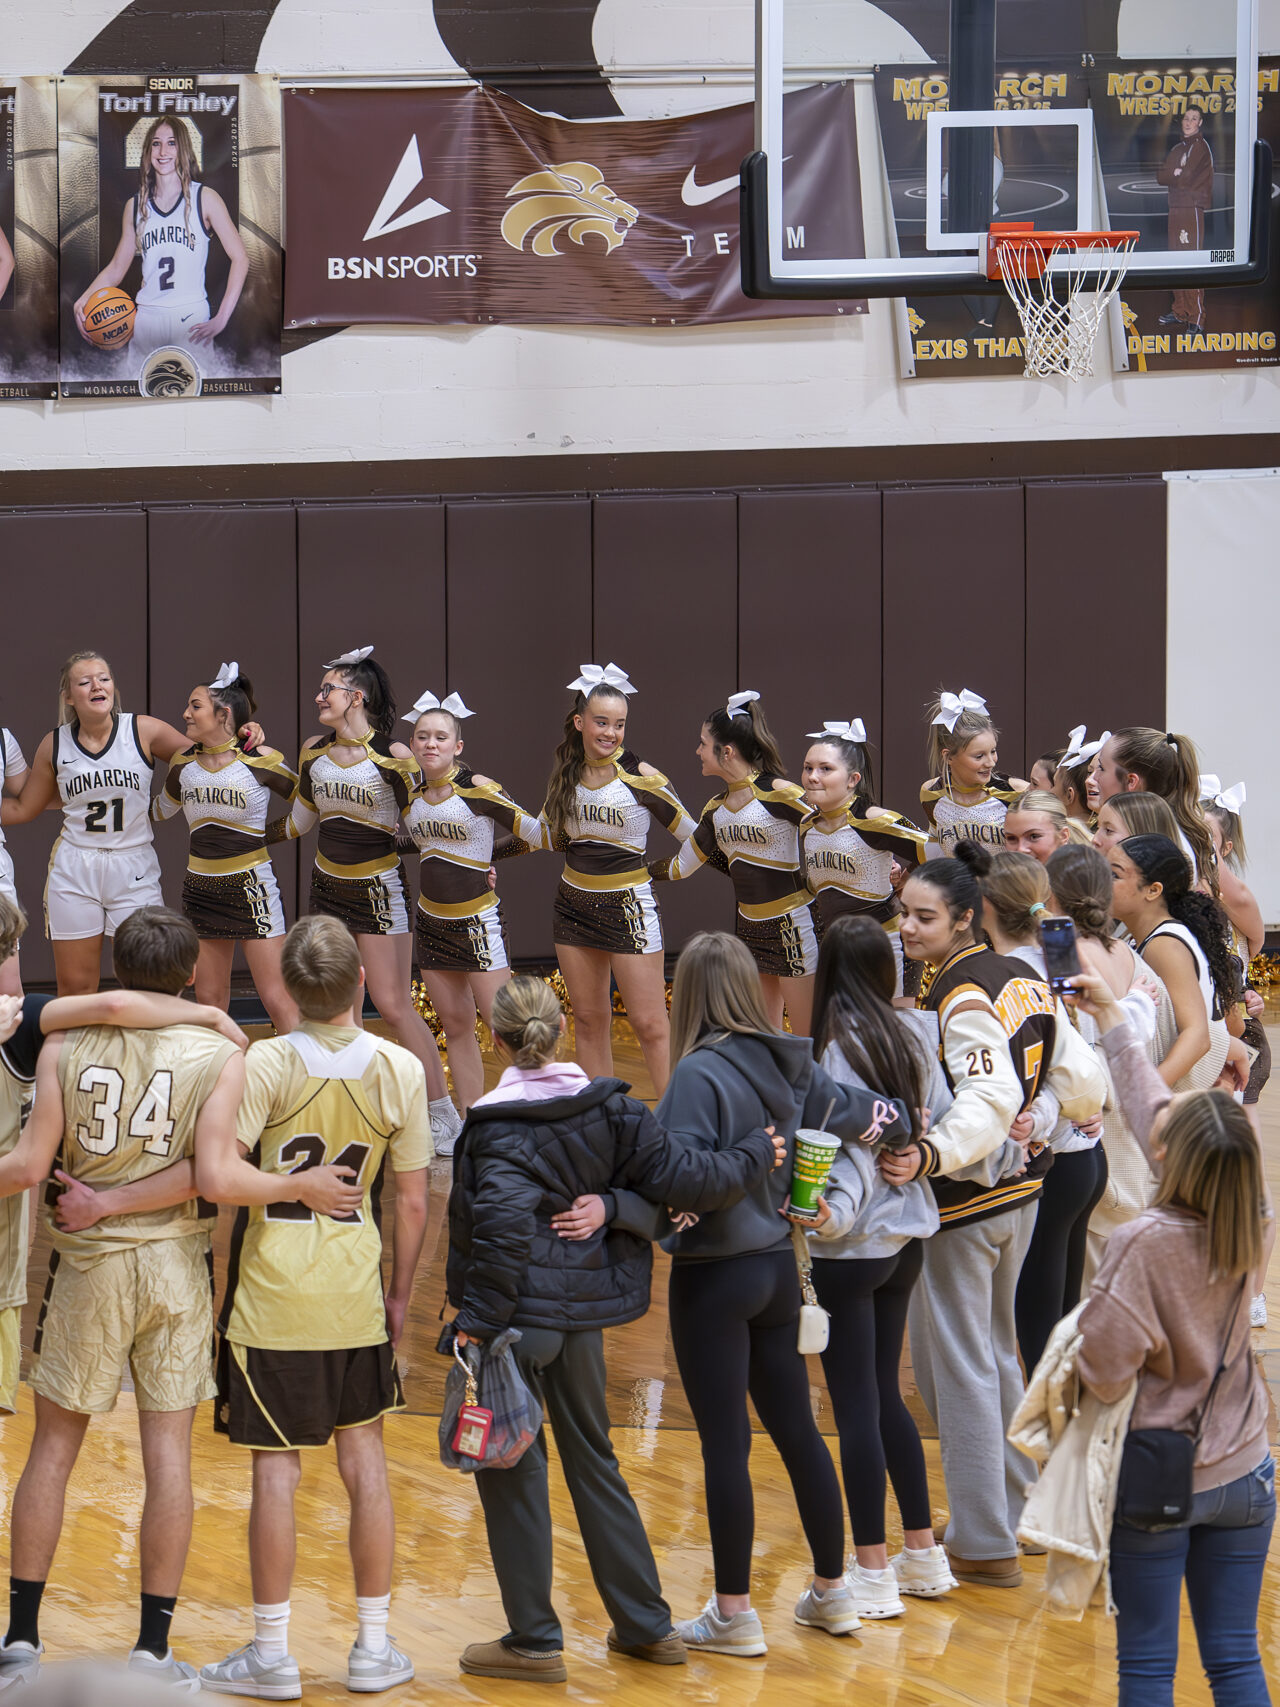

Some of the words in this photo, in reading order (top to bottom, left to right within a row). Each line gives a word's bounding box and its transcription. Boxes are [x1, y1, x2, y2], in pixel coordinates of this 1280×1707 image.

[149, 78, 193, 90] SENIOR
[893, 73, 1067, 101] MORCH
[1107, 69, 1279, 96] MONARH
[98, 92, 152, 113] Tori
[158, 92, 237, 116] Finley
[681, 226, 805, 257] TEM
[158, 256, 175, 291] 2
[90, 303, 128, 326] Wilson
[1176, 331, 1277, 353] HARDING
[84, 385, 136, 395] MONARCH
[203, 383, 253, 393] BASKETBALL
[65, 769, 140, 799] MONARCHS
[85, 797, 124, 833] 21
[579, 804, 624, 828] ARCHS
[966, 1049, 993, 1077] 26
[75, 1065, 175, 1157] 34
